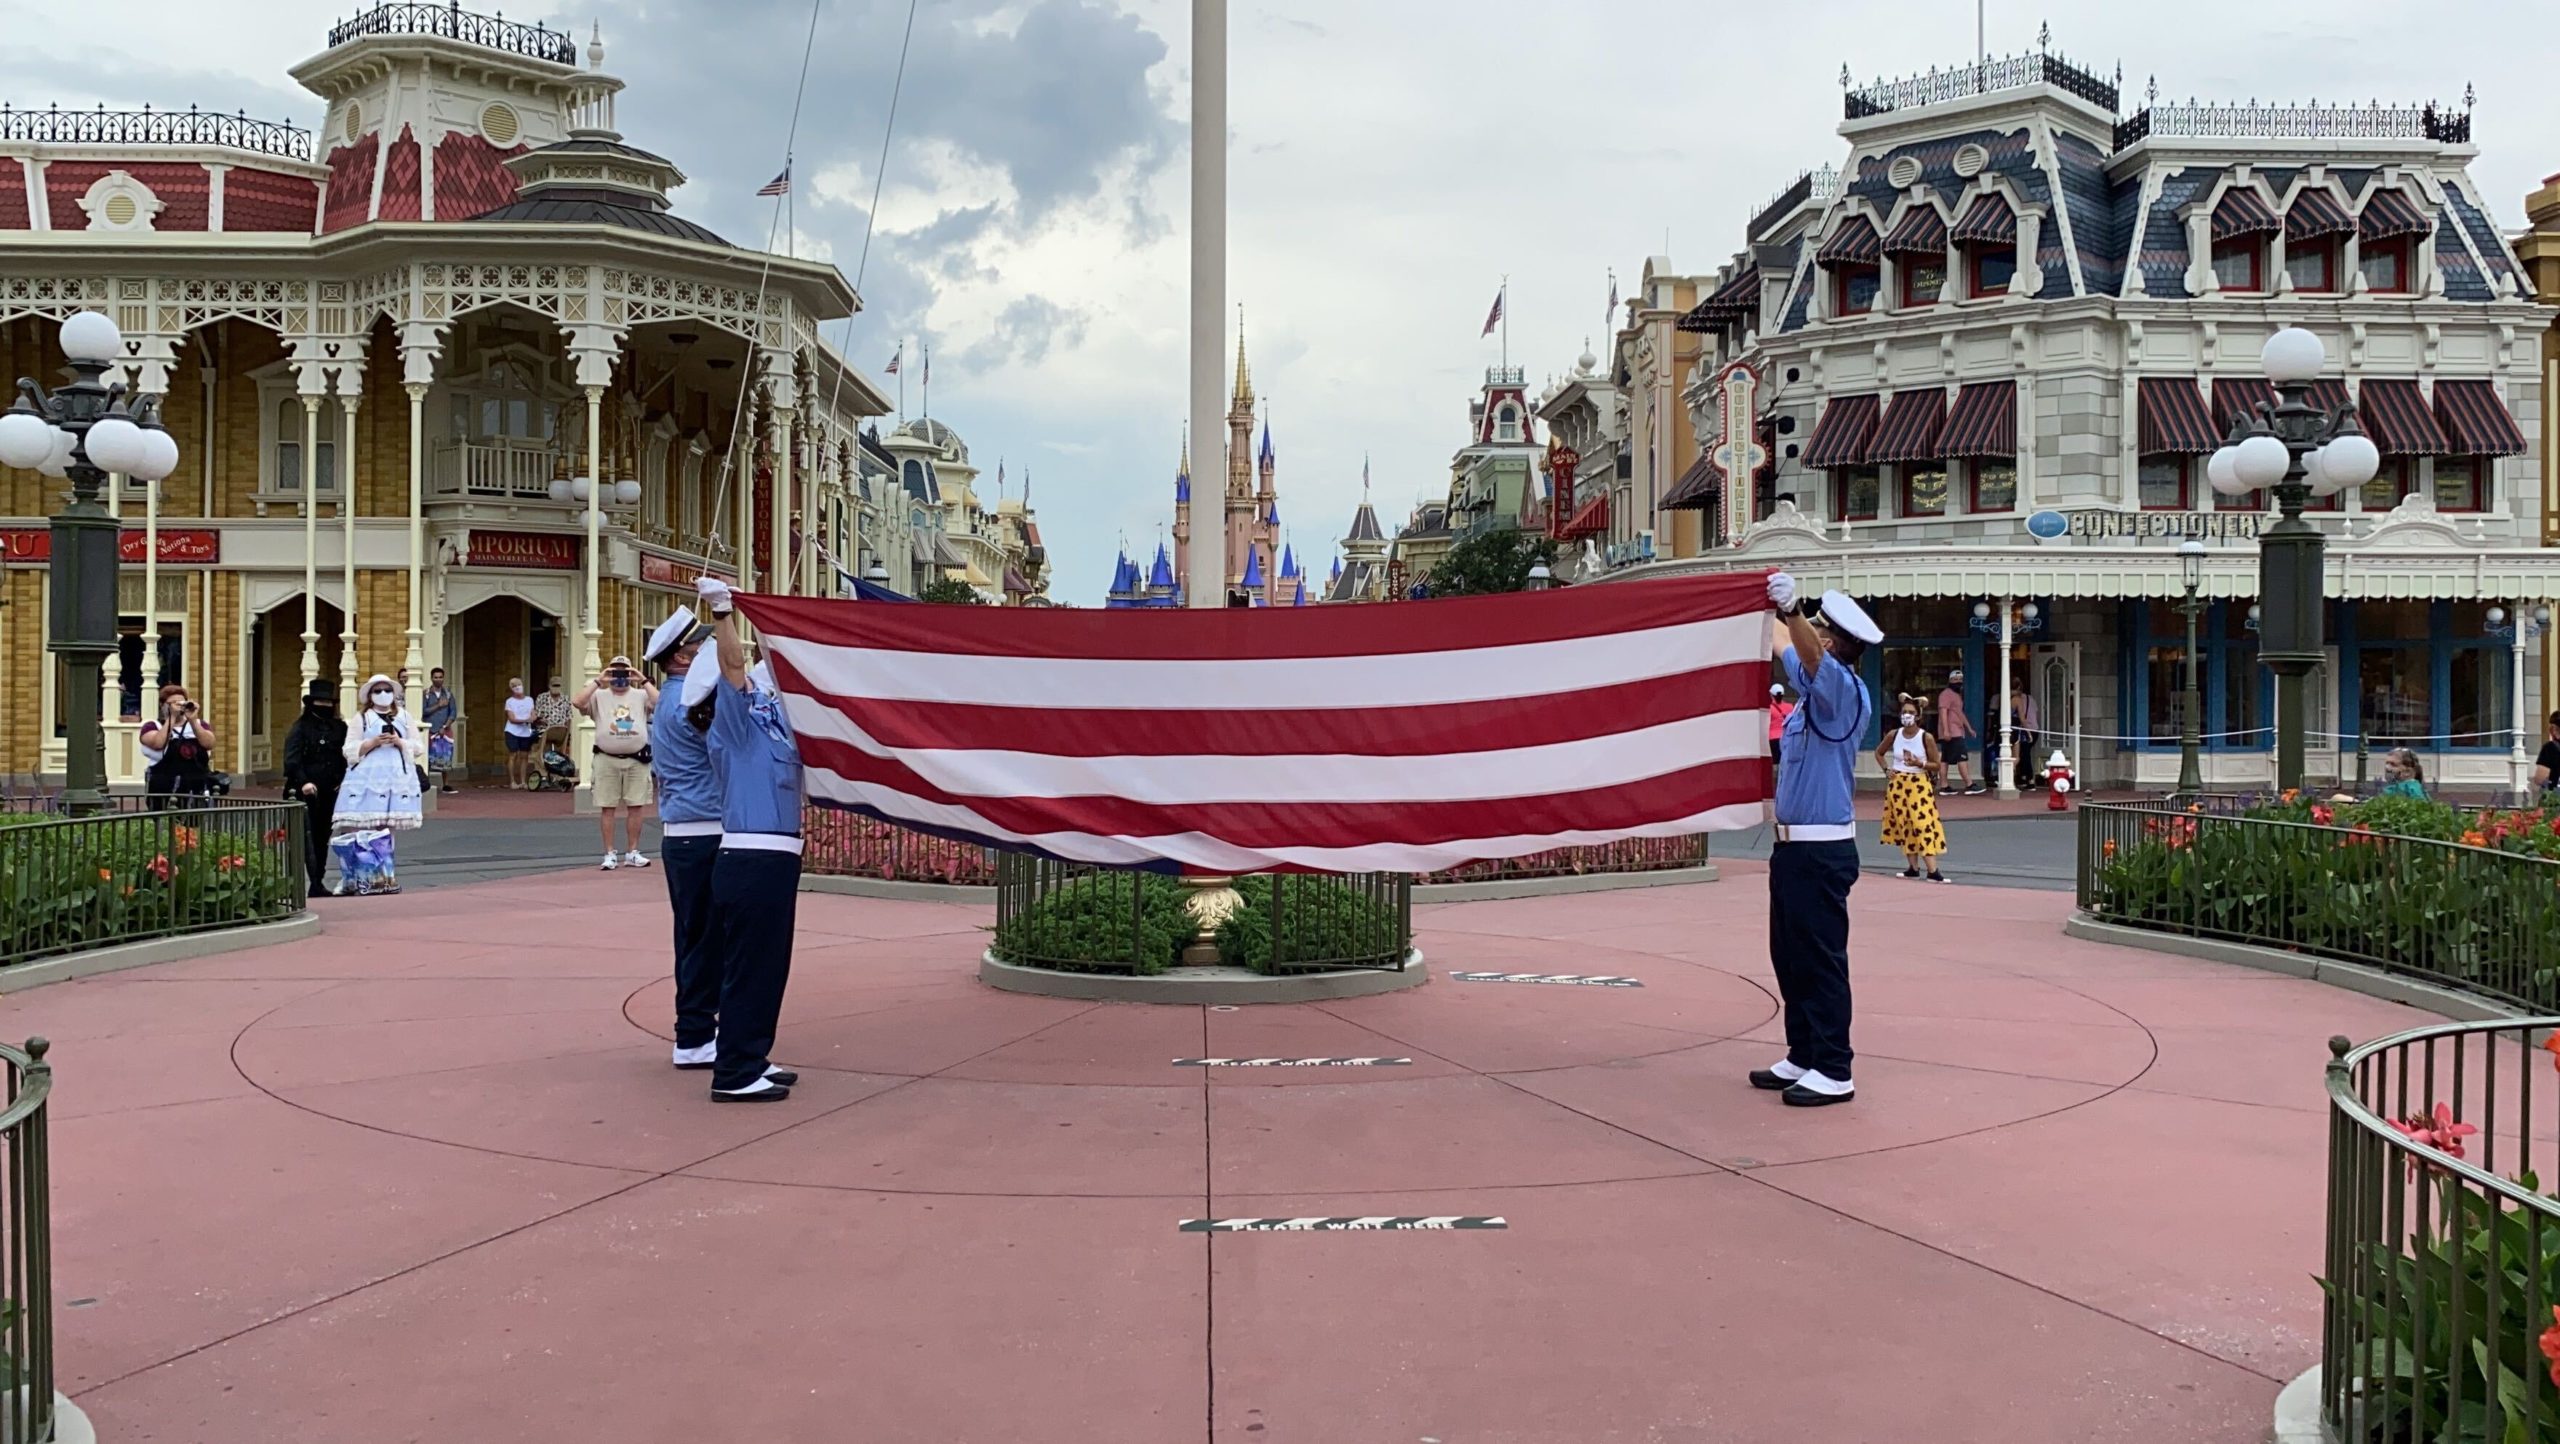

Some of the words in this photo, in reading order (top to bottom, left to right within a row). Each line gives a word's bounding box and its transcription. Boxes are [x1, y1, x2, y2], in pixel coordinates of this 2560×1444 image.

[1733, 382, 1747, 534] CONFECTIONERY
[758, 479, 770, 561] EMPORIUM
[123, 541, 139, 553] Dry
[160, 536, 191, 555] Notions
[191, 544, 210, 554] Toys
[1231, 1223, 1315, 1232] PLEASE
[1325, 1222, 1384, 1231] WAIT
[1396, 1222, 1455, 1230] HERE
